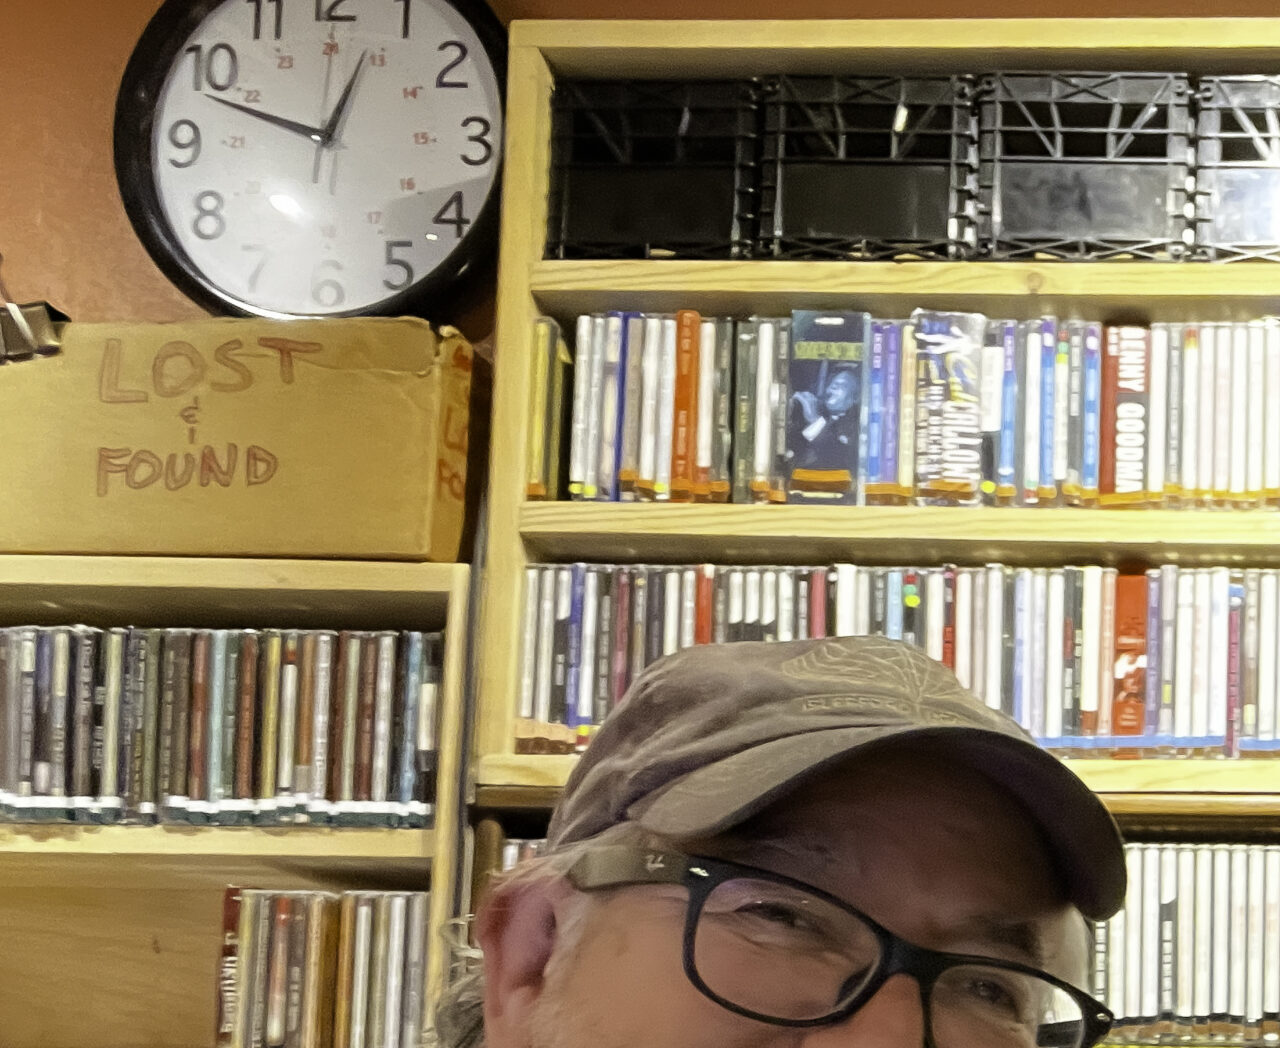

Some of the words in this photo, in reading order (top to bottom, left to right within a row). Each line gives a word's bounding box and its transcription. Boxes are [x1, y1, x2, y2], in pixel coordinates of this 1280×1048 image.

[247, 0, 283, 40] 11
[185, 43, 239, 91] 10
[277, 55, 293, 68] 23
[435, 40, 469, 88] 2
[244, 90, 261, 103] 22
[168, 119, 201, 168] 9
[229, 136, 245, 149] 21
[413, 132, 429, 144] 15
[460, 117, 492, 165] 3
[193, 190, 225, 240] 8
[432, 191, 470, 238] 4
[241, 244, 271, 292] 7
[312, 259, 345, 307] 6
[382, 240, 413, 290] 5
[101, 337, 323, 404] LOST
[97, 443, 278, 497] FOUND
[1115, 402, 1146, 493] GOODMA
